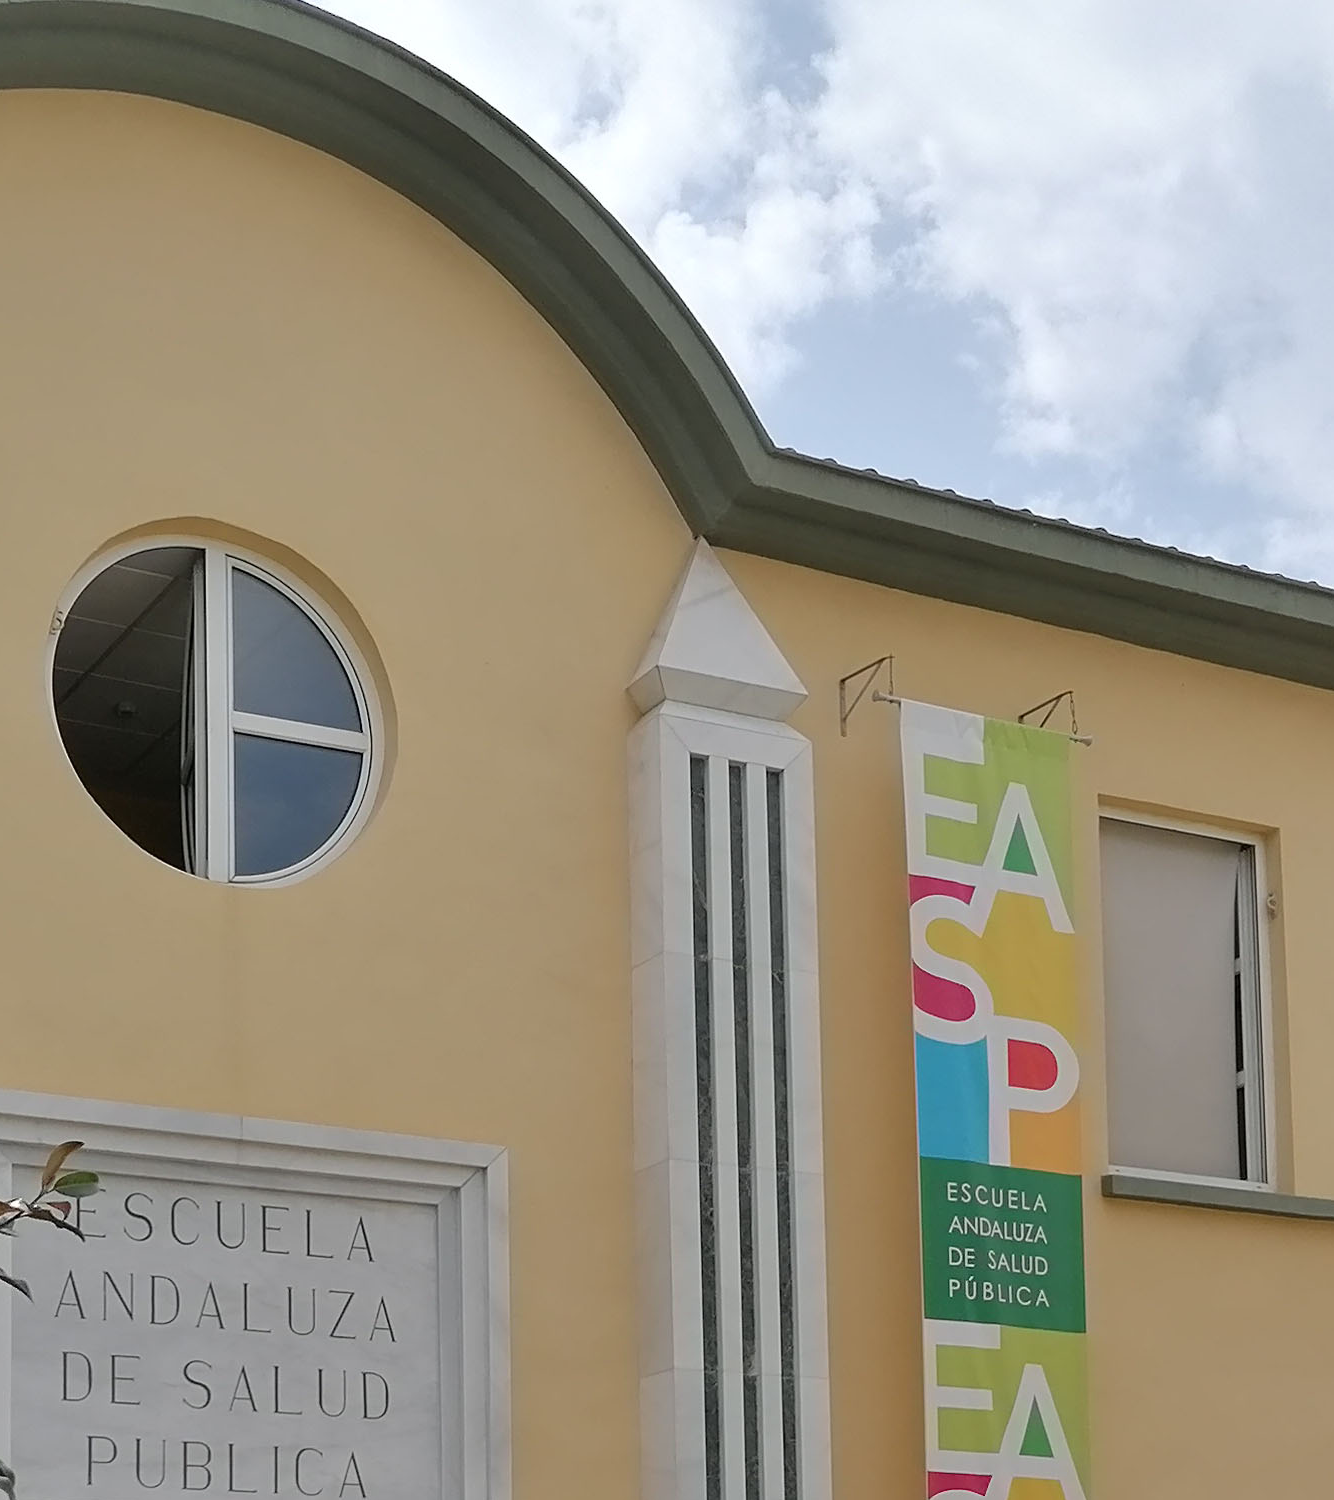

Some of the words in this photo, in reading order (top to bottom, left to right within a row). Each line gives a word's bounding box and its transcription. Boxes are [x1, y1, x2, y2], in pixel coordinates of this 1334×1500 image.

[946, 1181, 1048, 1213] ESCUELA
[75, 1187, 376, 1264] ESCUELA
[948, 1215, 1048, 1245] ANDALUZA
[948, 1246, 976, 1268] DE
[988, 1250, 1049, 1276] SALUD
[54, 1270, 398, 1343] ANDALUZA
[949, 1276, 1050, 1308] PÚBLICA
[61, 1351, 142, 1406] DE
[181, 1359, 391, 1421] SALUD
[85, 1434, 369, 1500] PUBLICA
